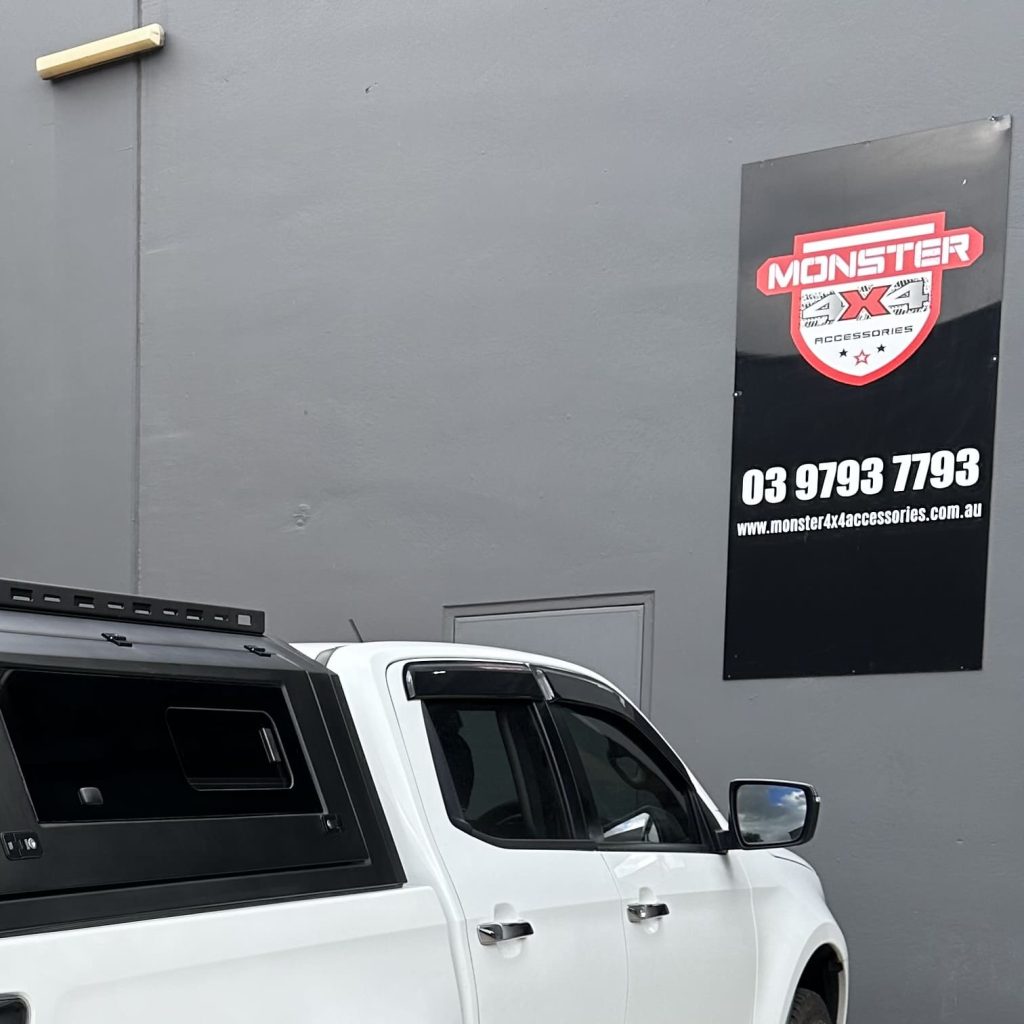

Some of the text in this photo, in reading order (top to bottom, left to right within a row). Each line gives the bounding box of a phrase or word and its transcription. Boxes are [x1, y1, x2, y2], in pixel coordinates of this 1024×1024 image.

[768, 233, 970, 290] MONSTER
[815, 325, 913, 345] ACCESSORIES
[741, 447, 980, 506] 03 9793 7793
[737, 502, 983, 537] www.monster4x4accessories.com.au
